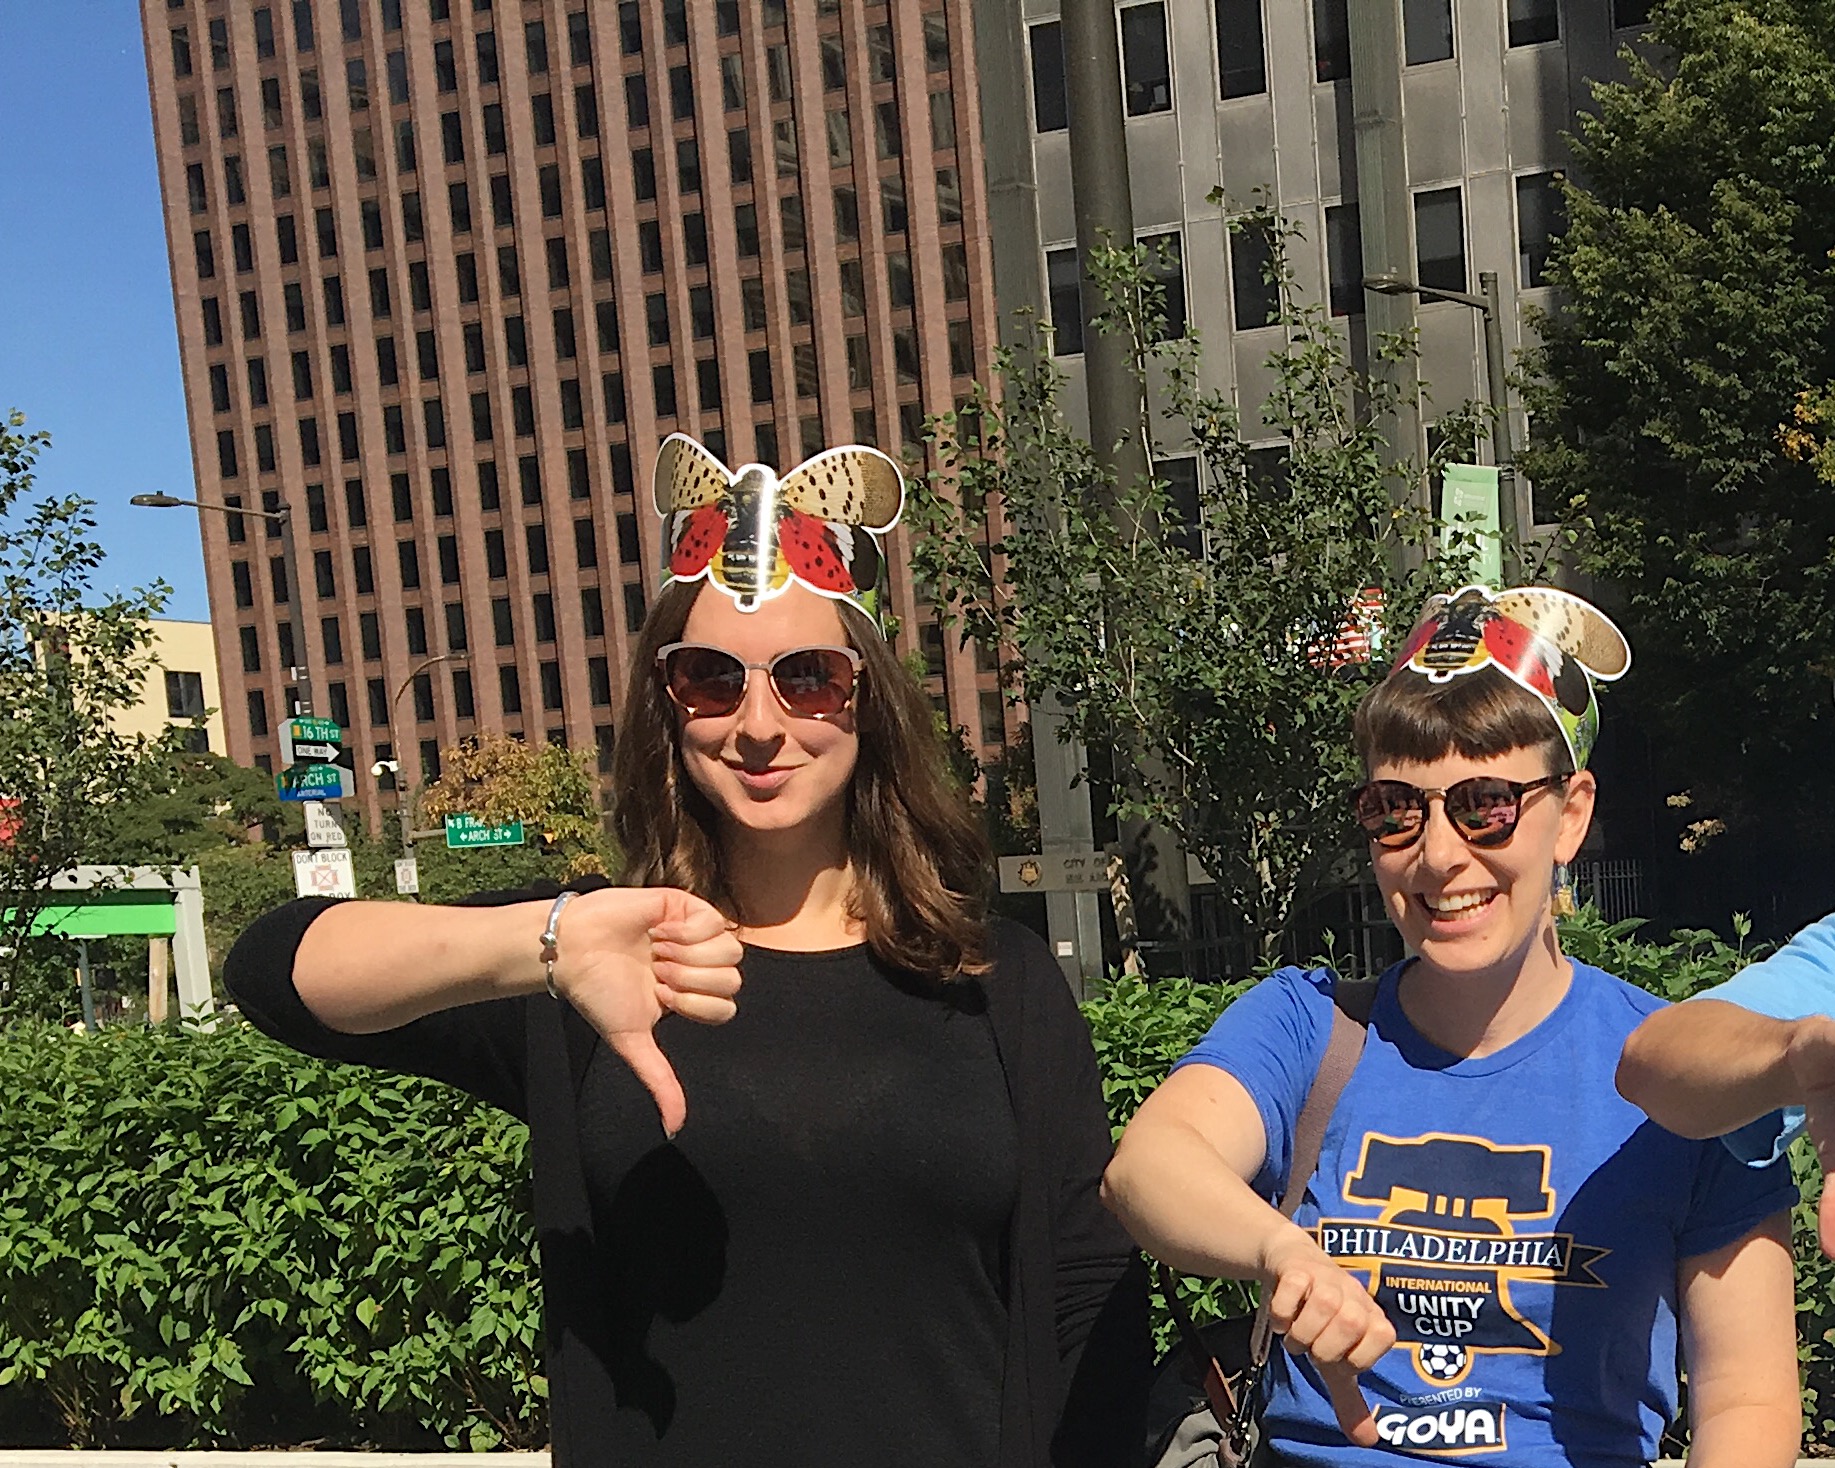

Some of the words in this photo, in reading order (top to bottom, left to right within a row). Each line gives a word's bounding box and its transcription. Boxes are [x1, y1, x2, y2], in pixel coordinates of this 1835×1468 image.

[303, 726, 314, 740] 16
[315, 727, 328, 739] TH
[329, 729, 339, 738] ST
[293, 773, 324, 788] ARCH
[326, 773, 336, 783] ST
[314, 820, 337, 828] TURN
[311, 832, 322, 840] ON
[327, 832, 342, 840] RED
[468, 830, 490, 841] ARCH
[321, 854, 347, 862] BLOCK
[1322, 1228, 1564, 1268] PHILADELPHIA
[1385, 1276, 1492, 1294] INTERNATIONAL
[1397, 1293, 1486, 1320] UNITY
[1414, 1316, 1474, 1339] CUP
[1400, 1388, 1462, 1405] PRESENTED
[1465, 1387, 1482, 1398] BY
[1376, 1409, 1495, 1446] GOYA
